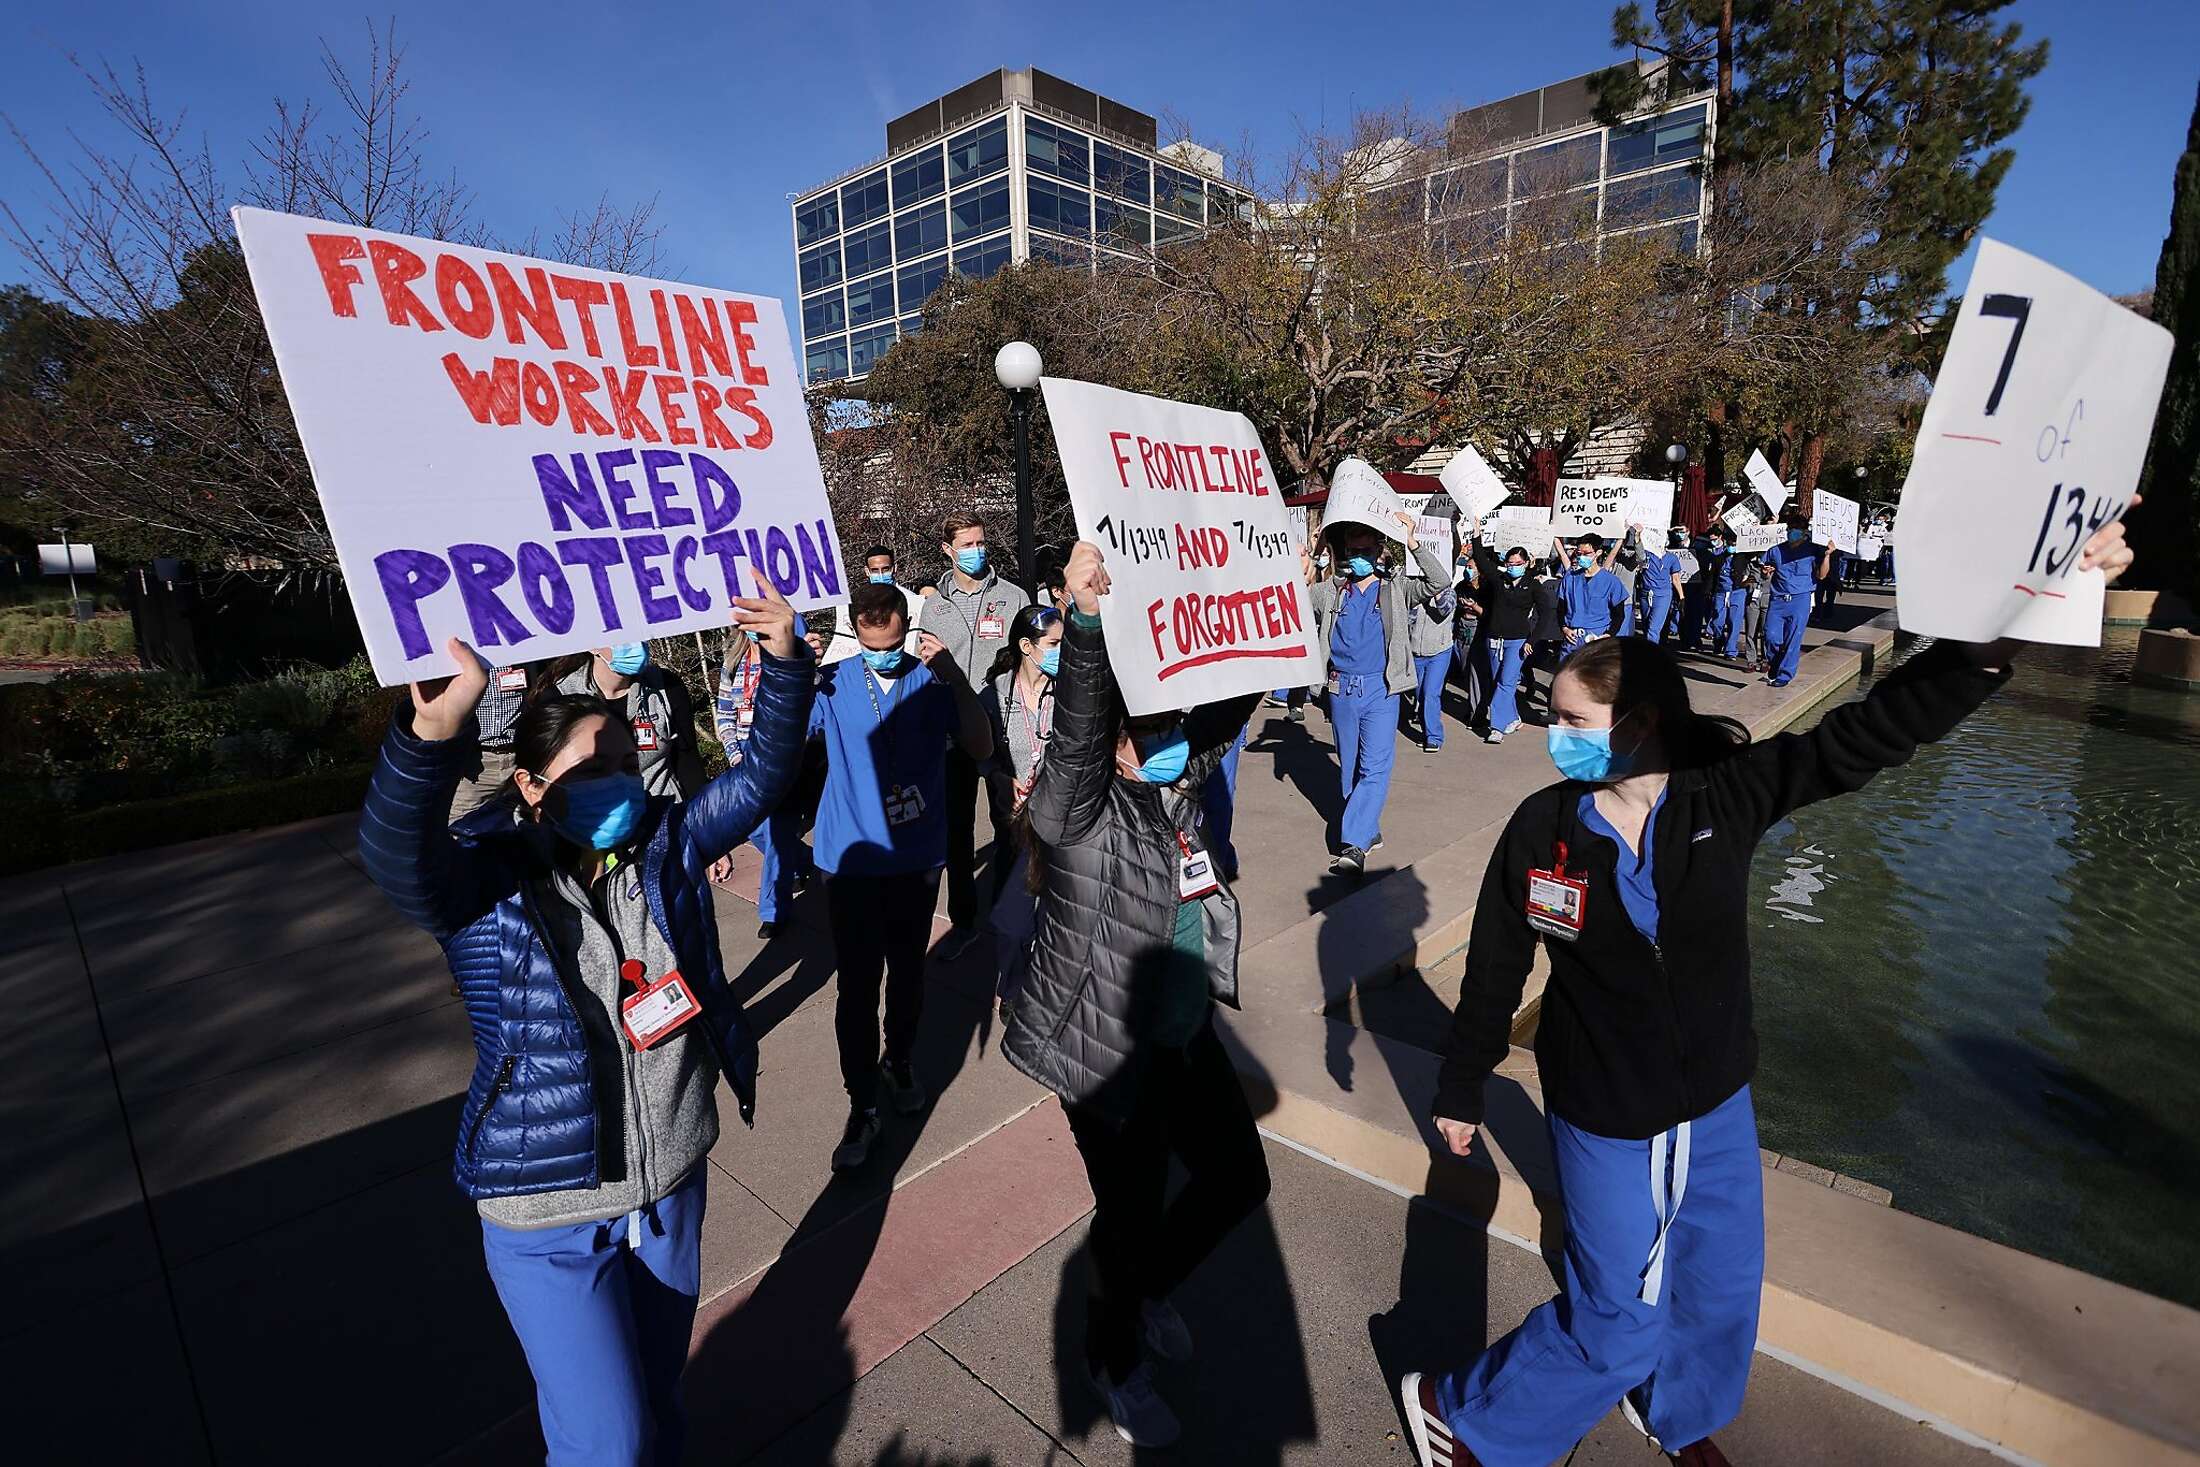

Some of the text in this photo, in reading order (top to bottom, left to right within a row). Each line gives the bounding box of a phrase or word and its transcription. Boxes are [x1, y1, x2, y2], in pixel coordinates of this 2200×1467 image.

[307, 233, 769, 386] FRONTLINE
[1980, 293, 2033, 416] 7
[441, 353, 773, 450] WORKERS
[532, 449, 741, 533] NEED
[1110, 431, 1269, 496] FRONTLINE
[1561, 485, 1628, 500] RESIDENTS
[1561, 504, 1585, 513] CAN
[1597, 503, 1617, 513] DIE
[1575, 516, 1603, 525] TOO
[1740, 527, 1766, 537] LACK
[1820, 494, 1839, 513] HELP
[2028, 483, 2123, 578] 134
[1096, 515, 1290, 570] 7/1349 AND 7/1349
[374, 519, 842, 660] PROTECTION
[1147, 581, 1303, 662] FORGOTTEN
